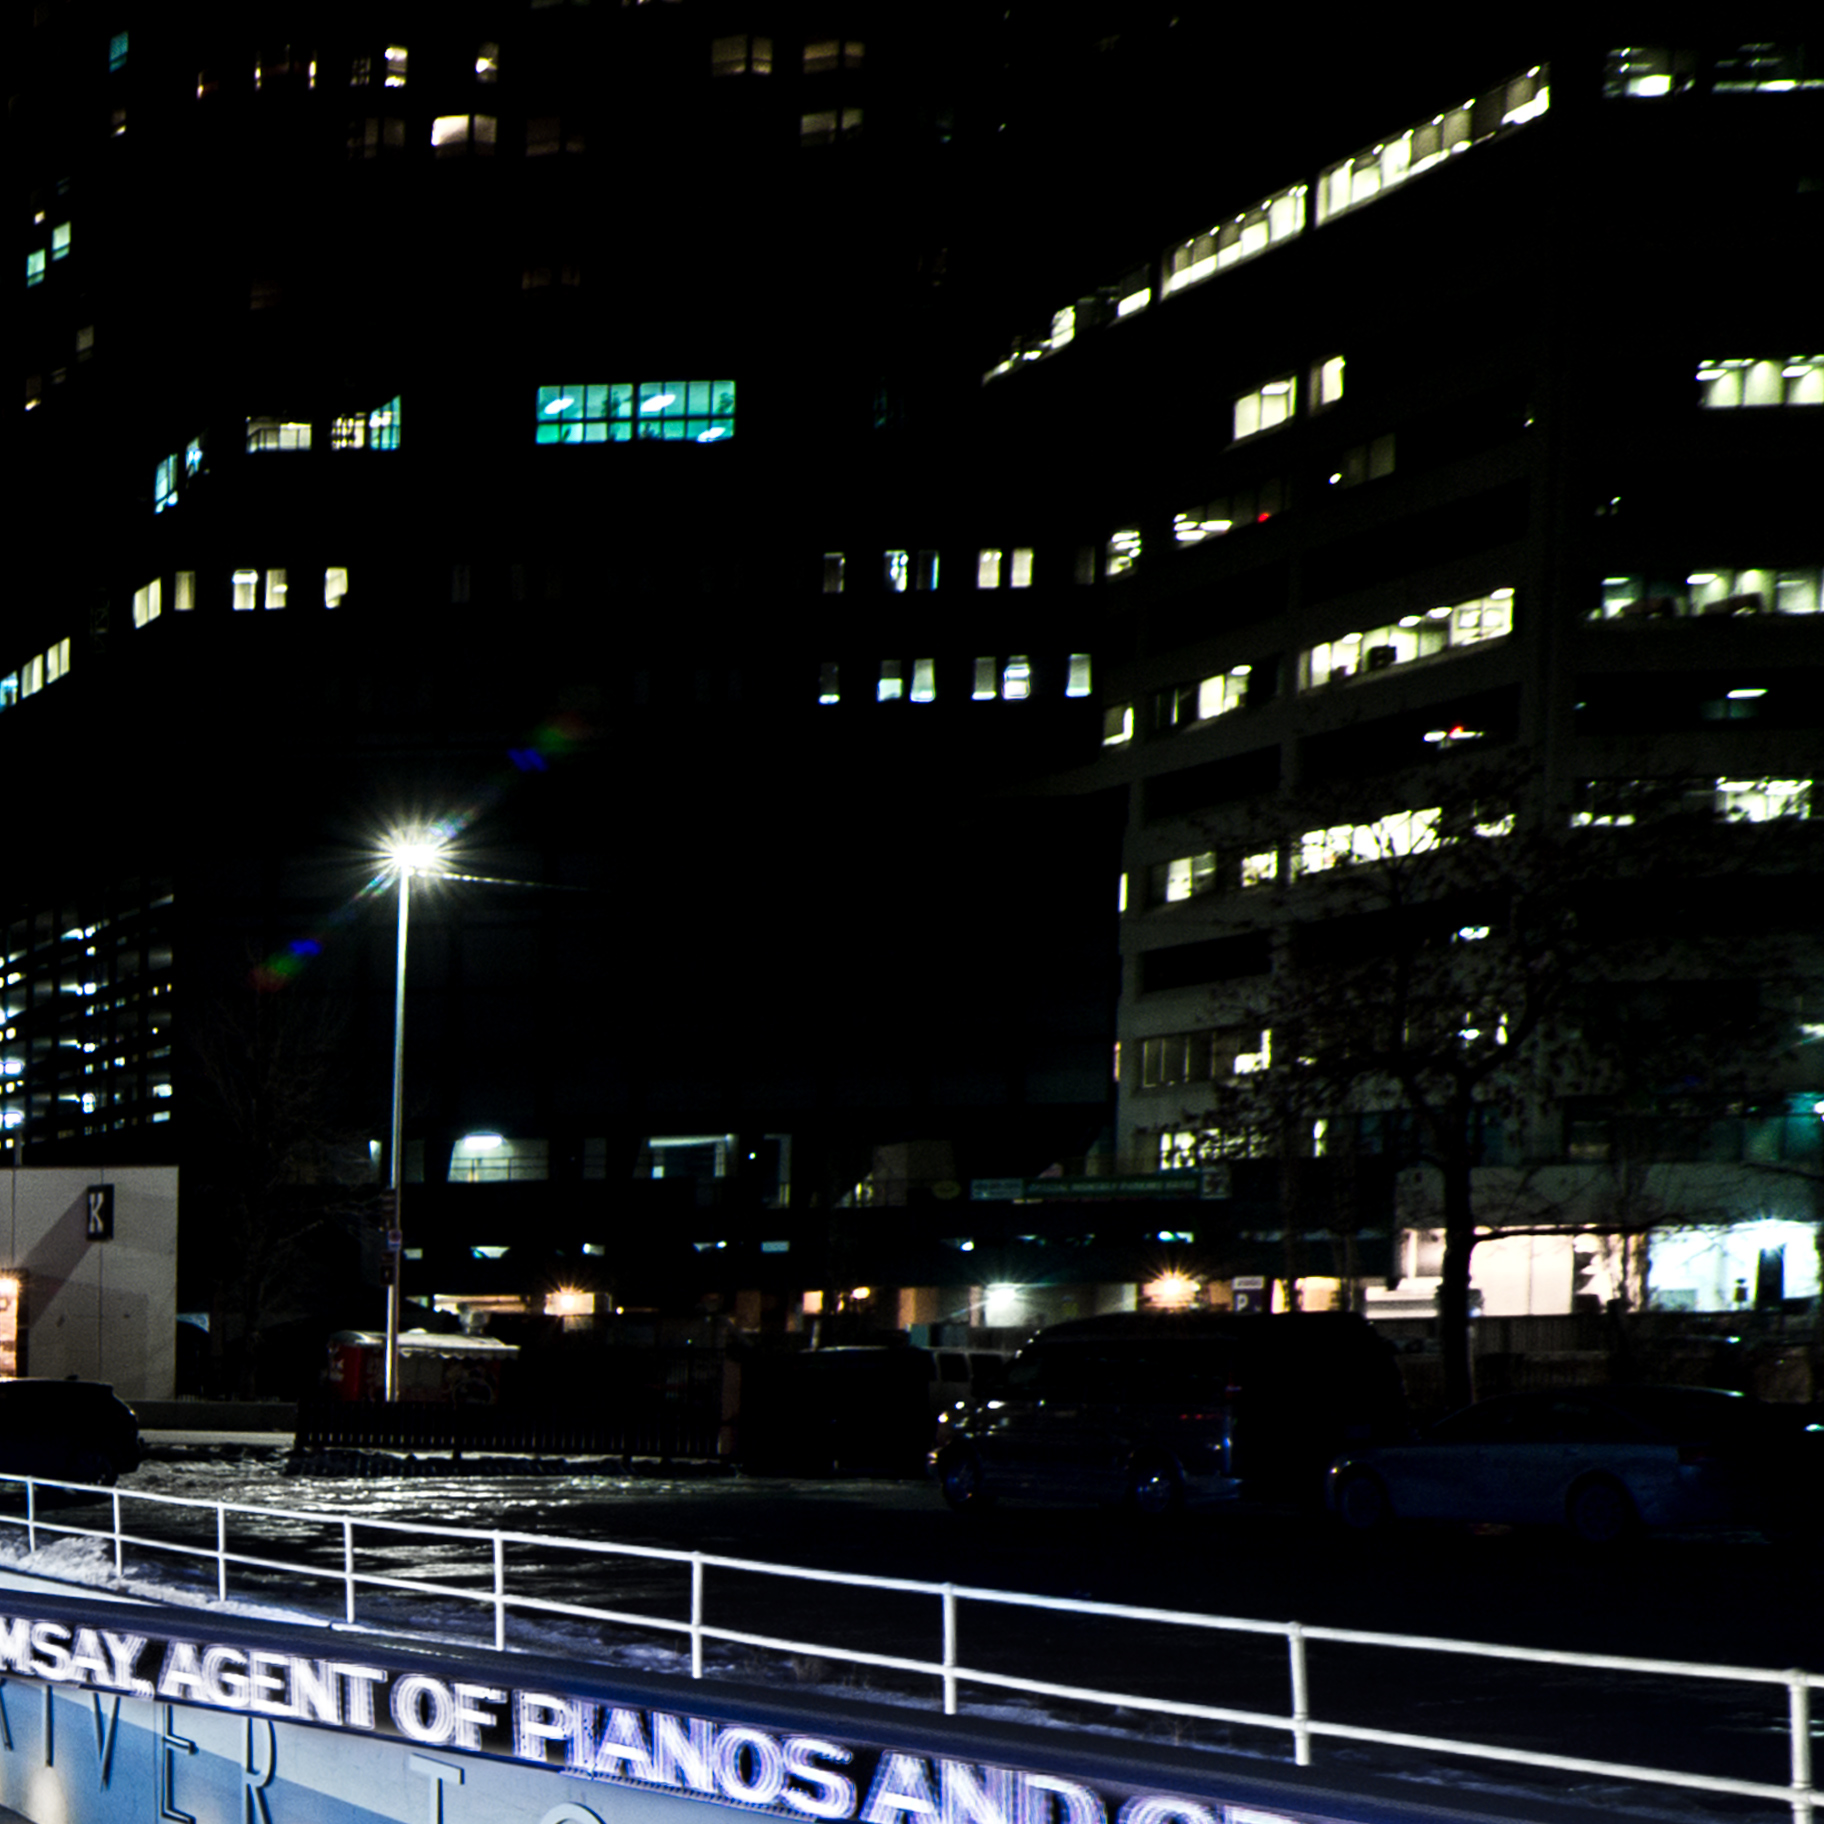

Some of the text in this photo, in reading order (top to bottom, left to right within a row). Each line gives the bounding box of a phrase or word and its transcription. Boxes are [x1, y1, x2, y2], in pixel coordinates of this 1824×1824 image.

[88, 1192, 104, 1233] K
[157, 1638, 388, 1730] AGENT
[389, 1672, 507, 1751] OF
[511, 1688, 857, 1821] PIANOS
